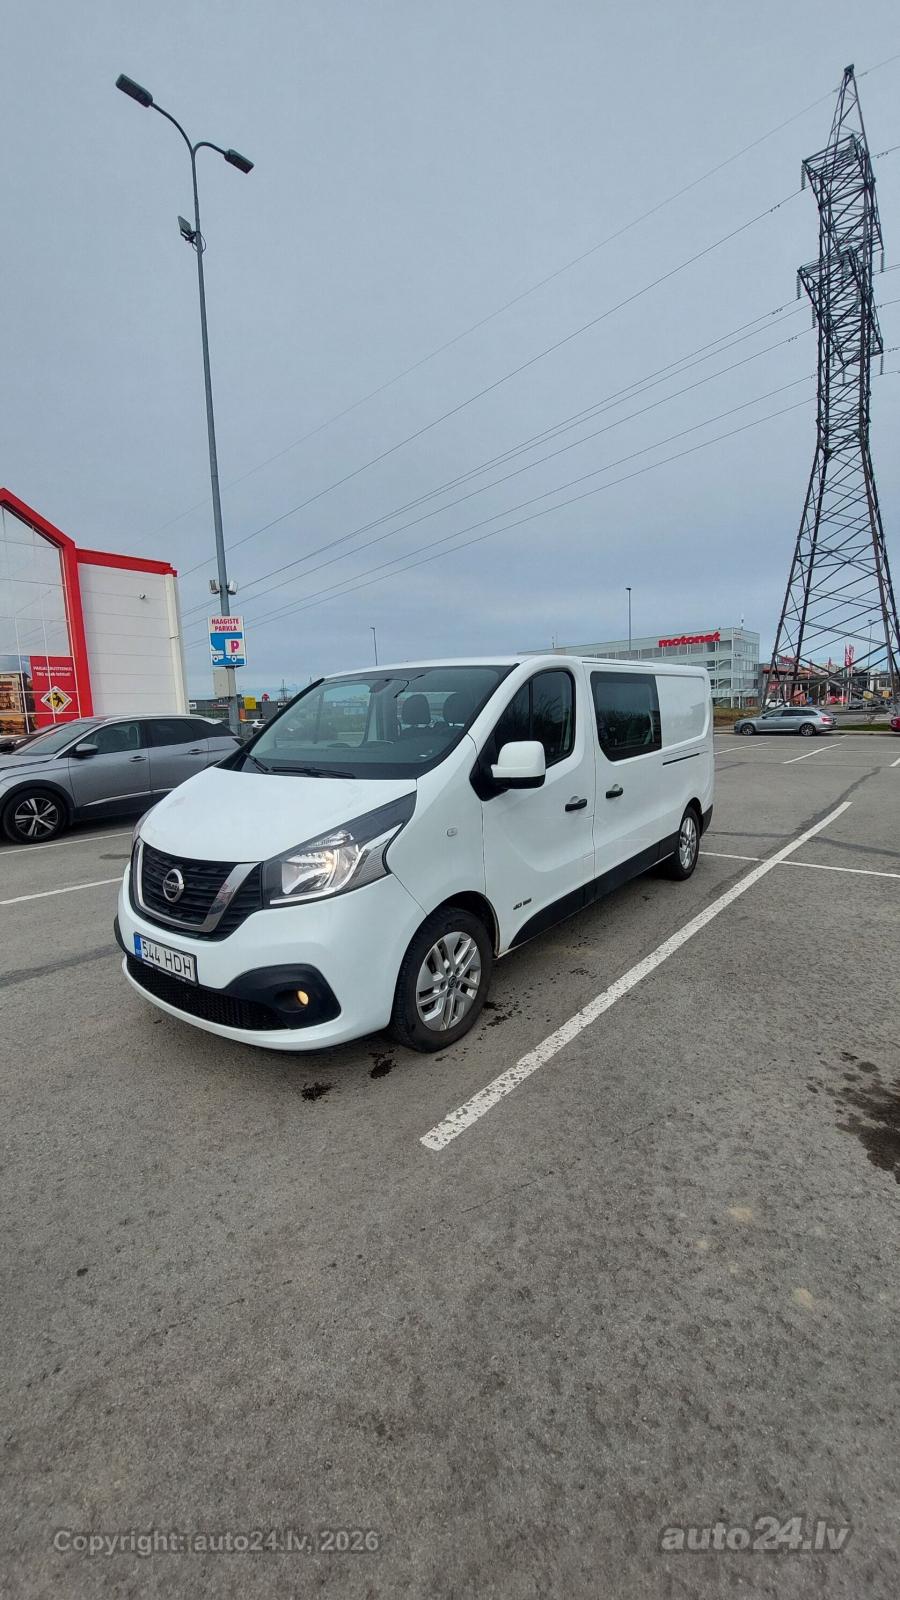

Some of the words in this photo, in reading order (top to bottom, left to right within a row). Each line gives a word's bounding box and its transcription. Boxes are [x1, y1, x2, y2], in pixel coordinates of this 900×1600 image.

[231, 640, 239, 653] P
[658, 631, 720, 648] motonet
[142, 941, 160, 964] 544
[164, 950, 192, 978] HDH
